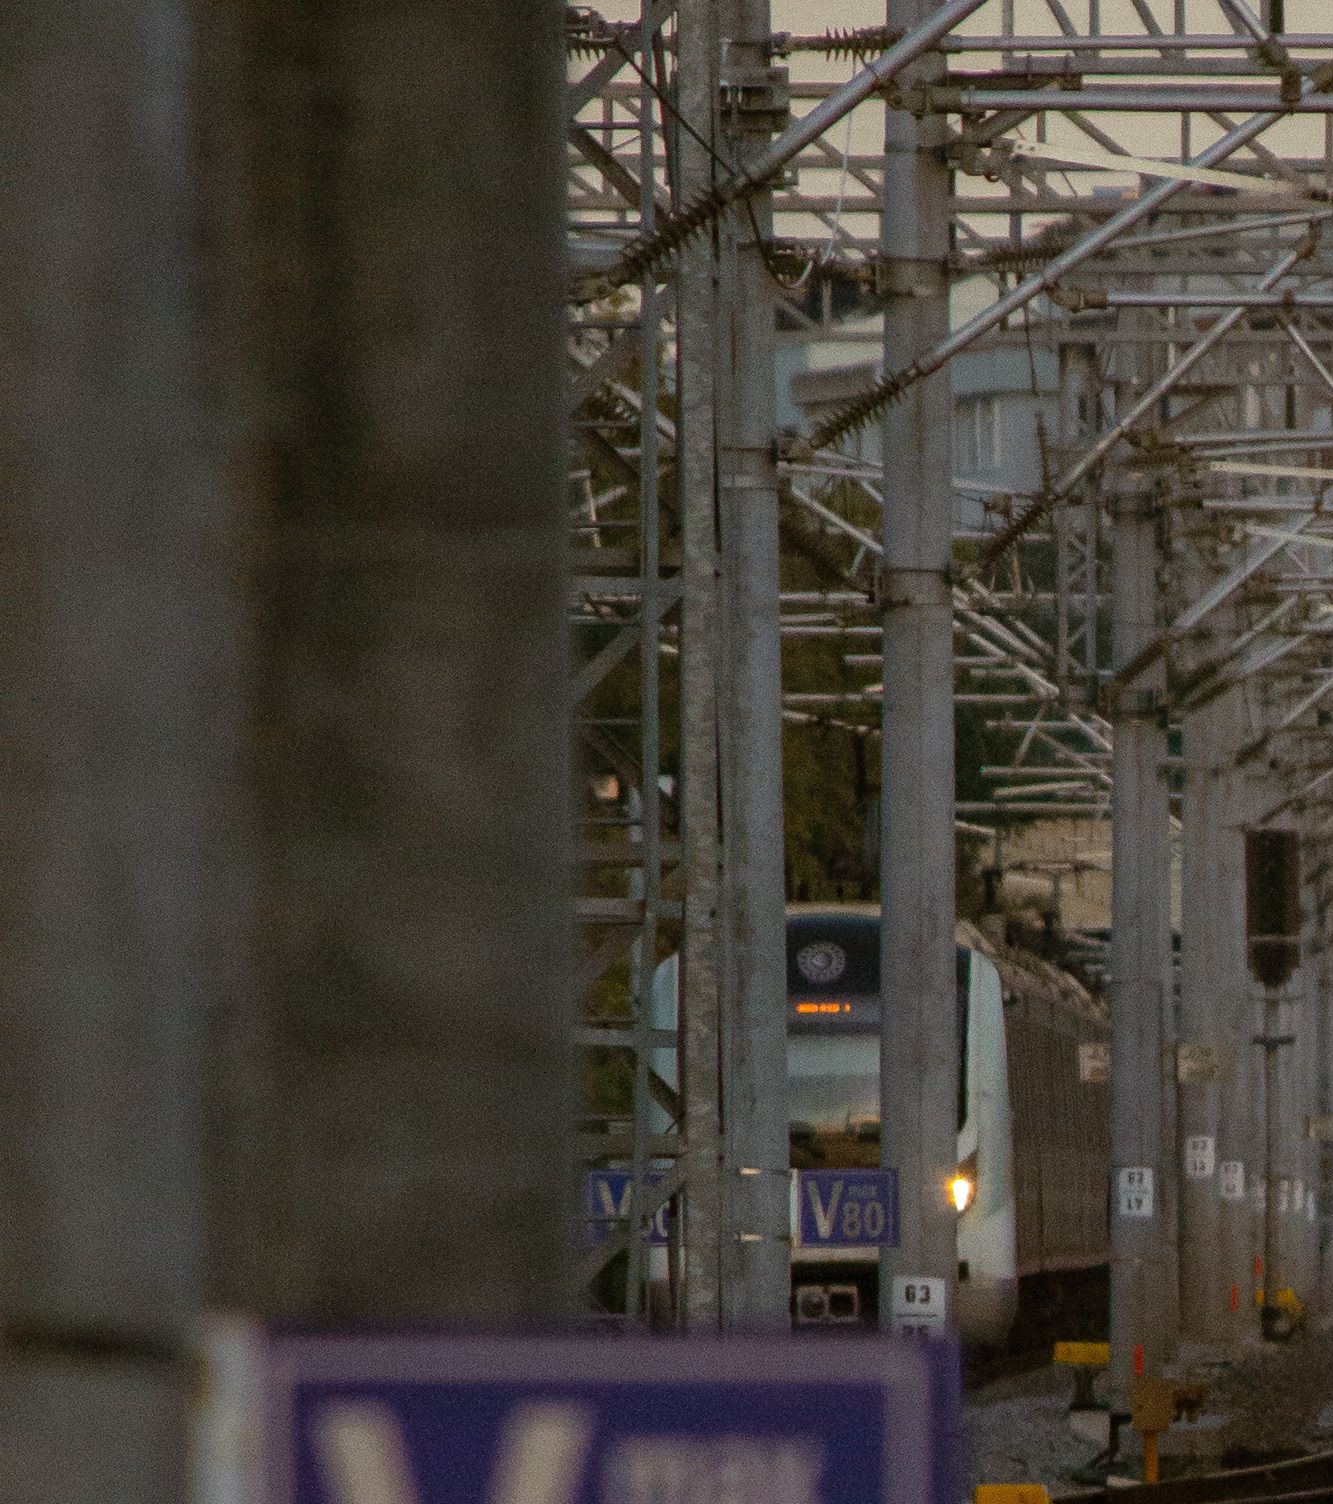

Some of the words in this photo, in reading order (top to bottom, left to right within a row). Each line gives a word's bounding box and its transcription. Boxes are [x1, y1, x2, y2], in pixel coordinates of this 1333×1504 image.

[807, 1180, 844, 1239] V
[843, 1201, 885, 1238] 80
[905, 1284, 931, 1303] 63
